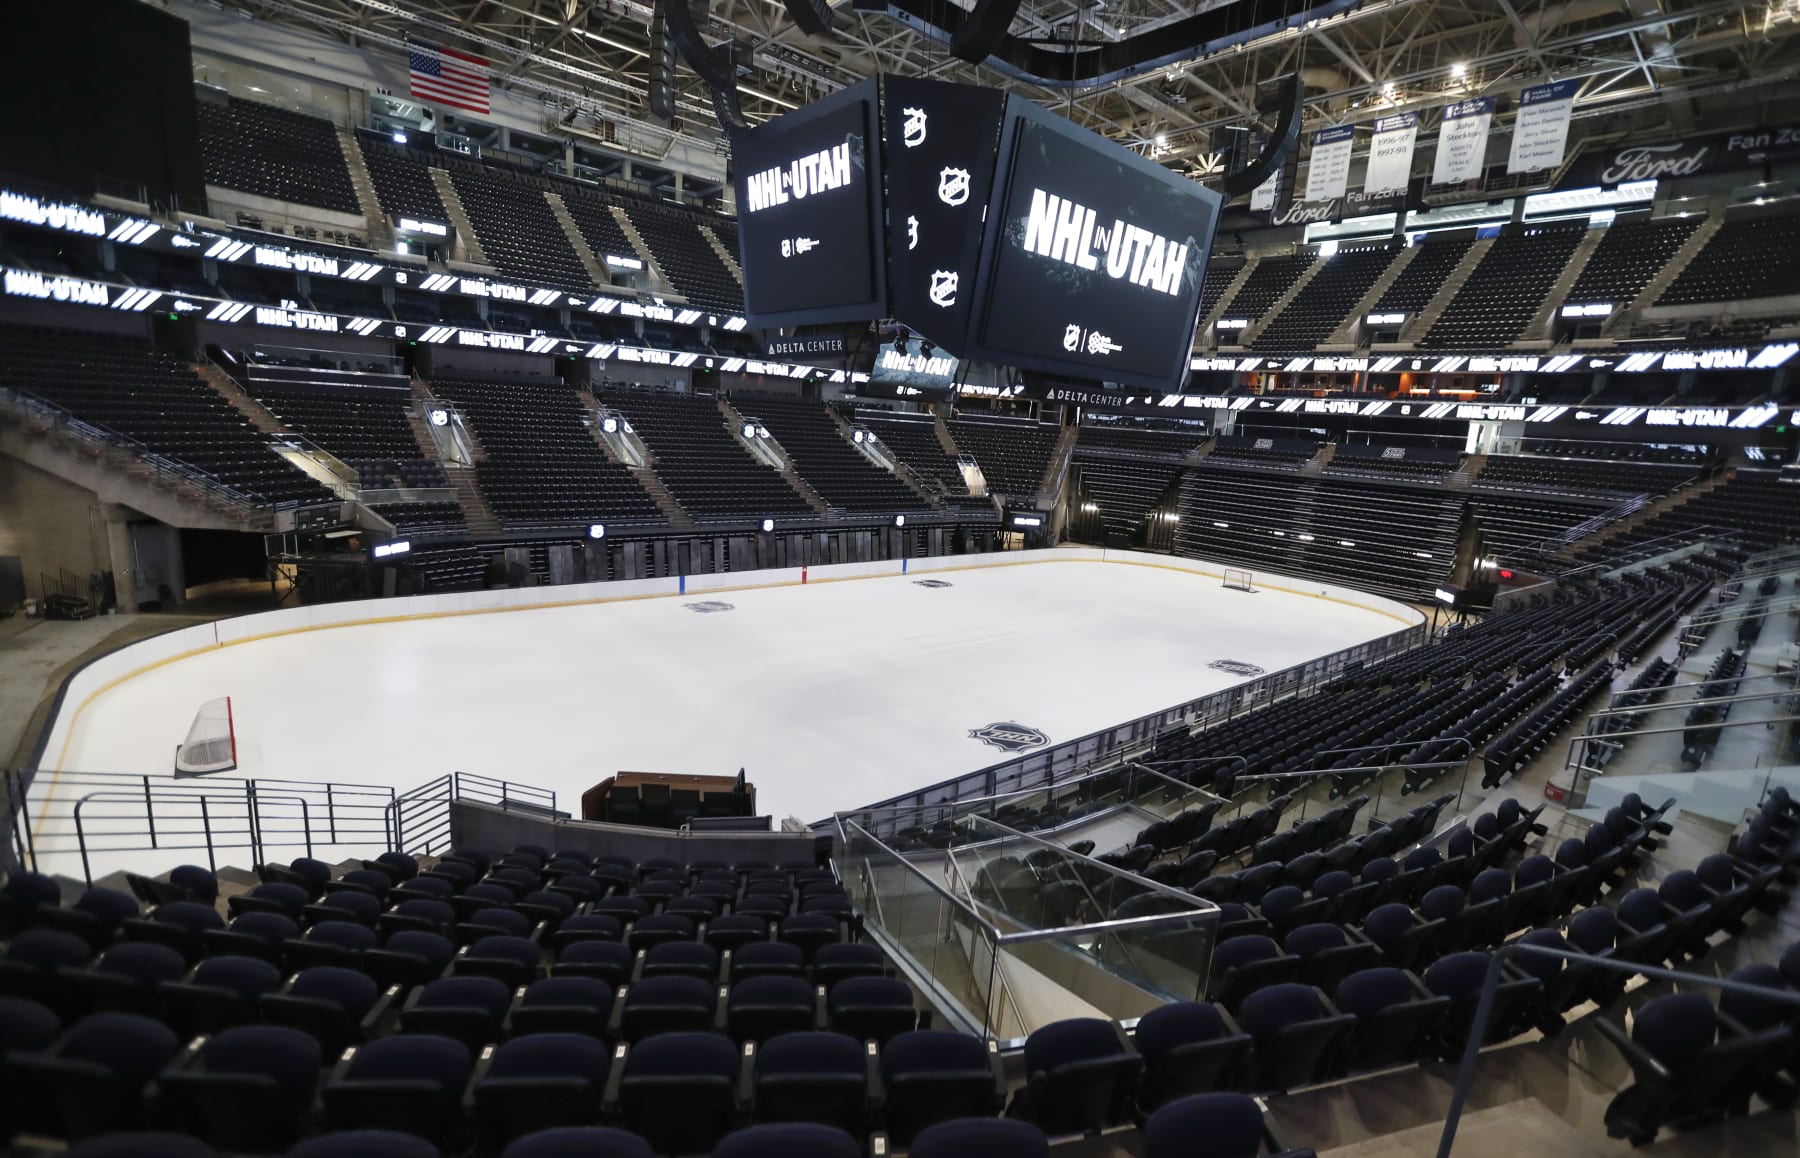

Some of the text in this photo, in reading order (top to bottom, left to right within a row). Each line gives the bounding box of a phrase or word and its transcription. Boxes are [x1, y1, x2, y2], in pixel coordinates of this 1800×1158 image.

[1456, 121, 1475, 131] John
[1446, 130, 1482, 143] Stockton
[1728, 134, 1771, 151] Fan
[1602, 143, 1708, 184] Ford
[747, 143, 850, 212] NHL IN UTAH
[1347, 191, 1371, 203] Fan
[1273, 199, 1335, 226] Ford
[1024, 188, 1188, 296] NHL IN UTAH
[295, 254, 338, 275] UTAH
[492, 284, 526, 301] UTAH
[295, 312, 338, 331] UTAH
[489, 334, 524, 350] UTAH
[777, 340, 843, 353] DELTA CENTER
[882, 350, 912, 371] NHL
[915, 355, 952, 376] UTAH
[1058, 390, 1122, 407] DELTA CENTER
